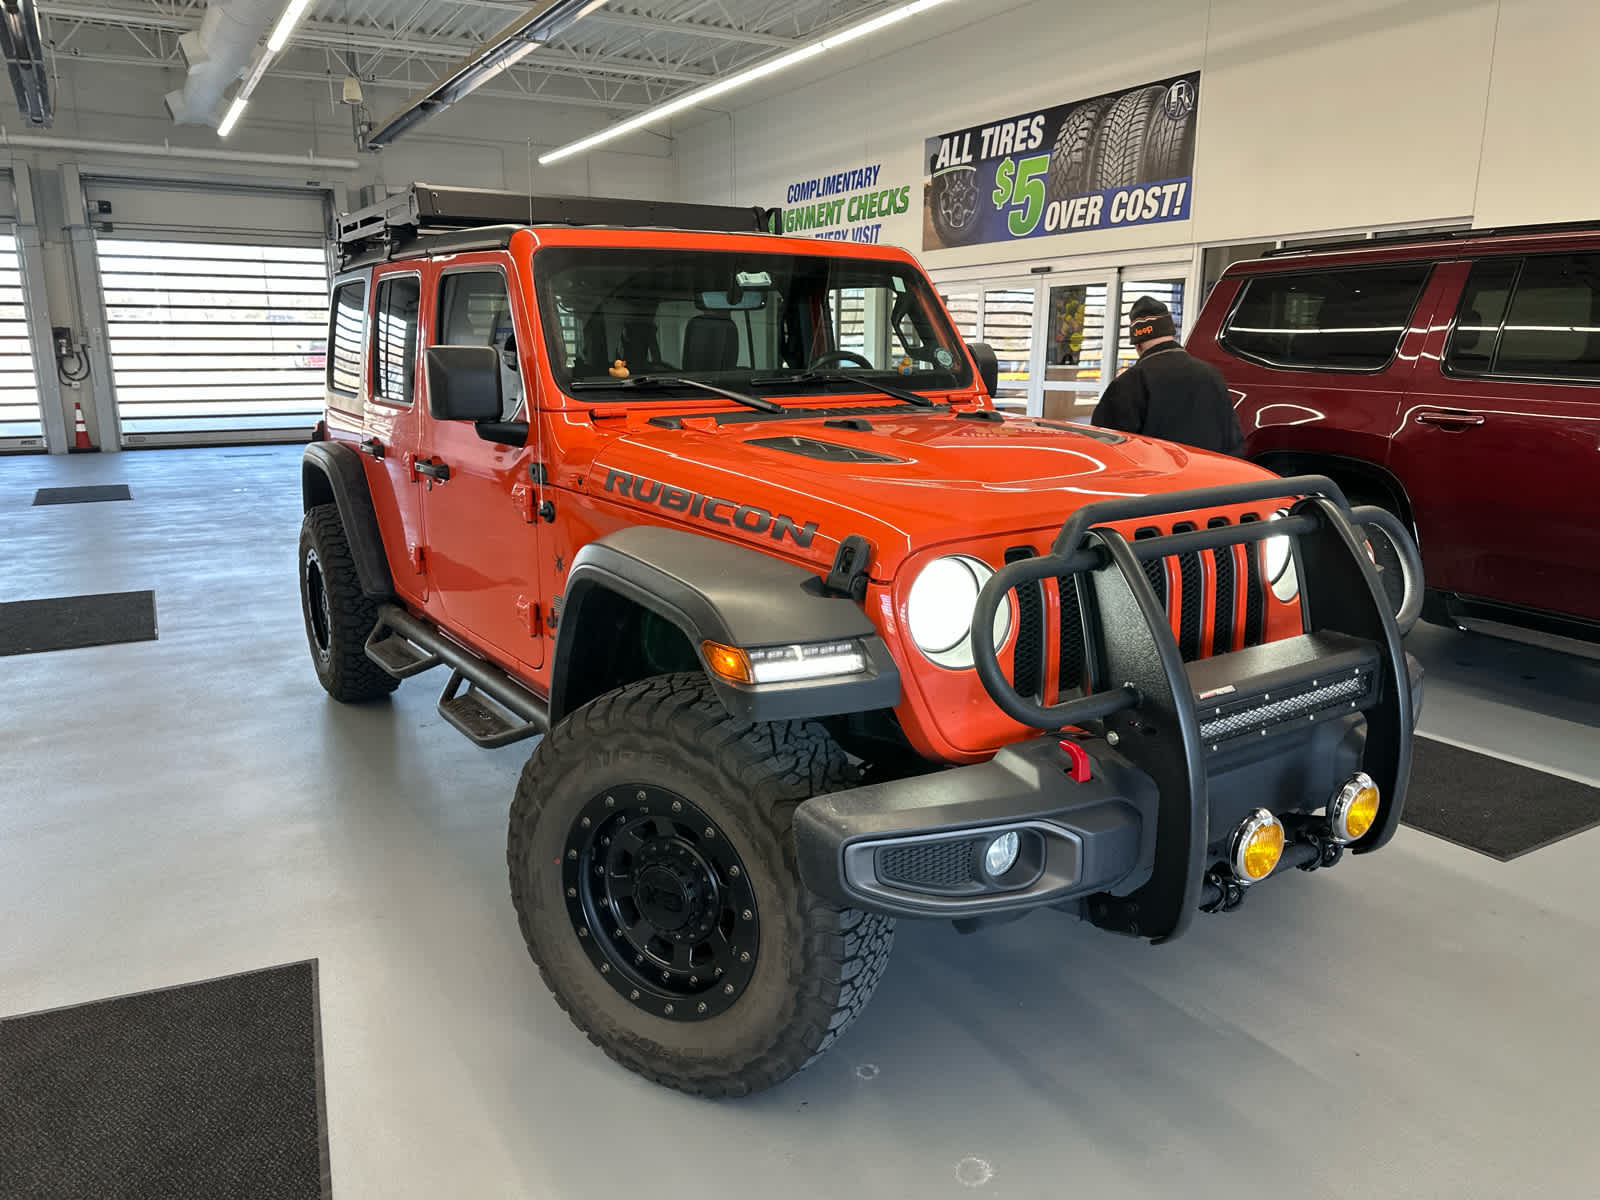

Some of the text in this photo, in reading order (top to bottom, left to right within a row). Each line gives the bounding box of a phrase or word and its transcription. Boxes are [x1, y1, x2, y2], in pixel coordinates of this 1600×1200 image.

[935, 115, 1046, 170] ALL TIRES
[786, 164, 881, 204] COMPLIMENTARY
[992, 155, 1051, 237] $5
[1044, 181, 1187, 232] OVER COST!
[768, 185, 911, 233] IGNMENT CHECKS
[851, 223, 882, 244] VISIT
[1133, 325, 1153, 337] Jeep
[604, 468, 820, 549] RUBICON
